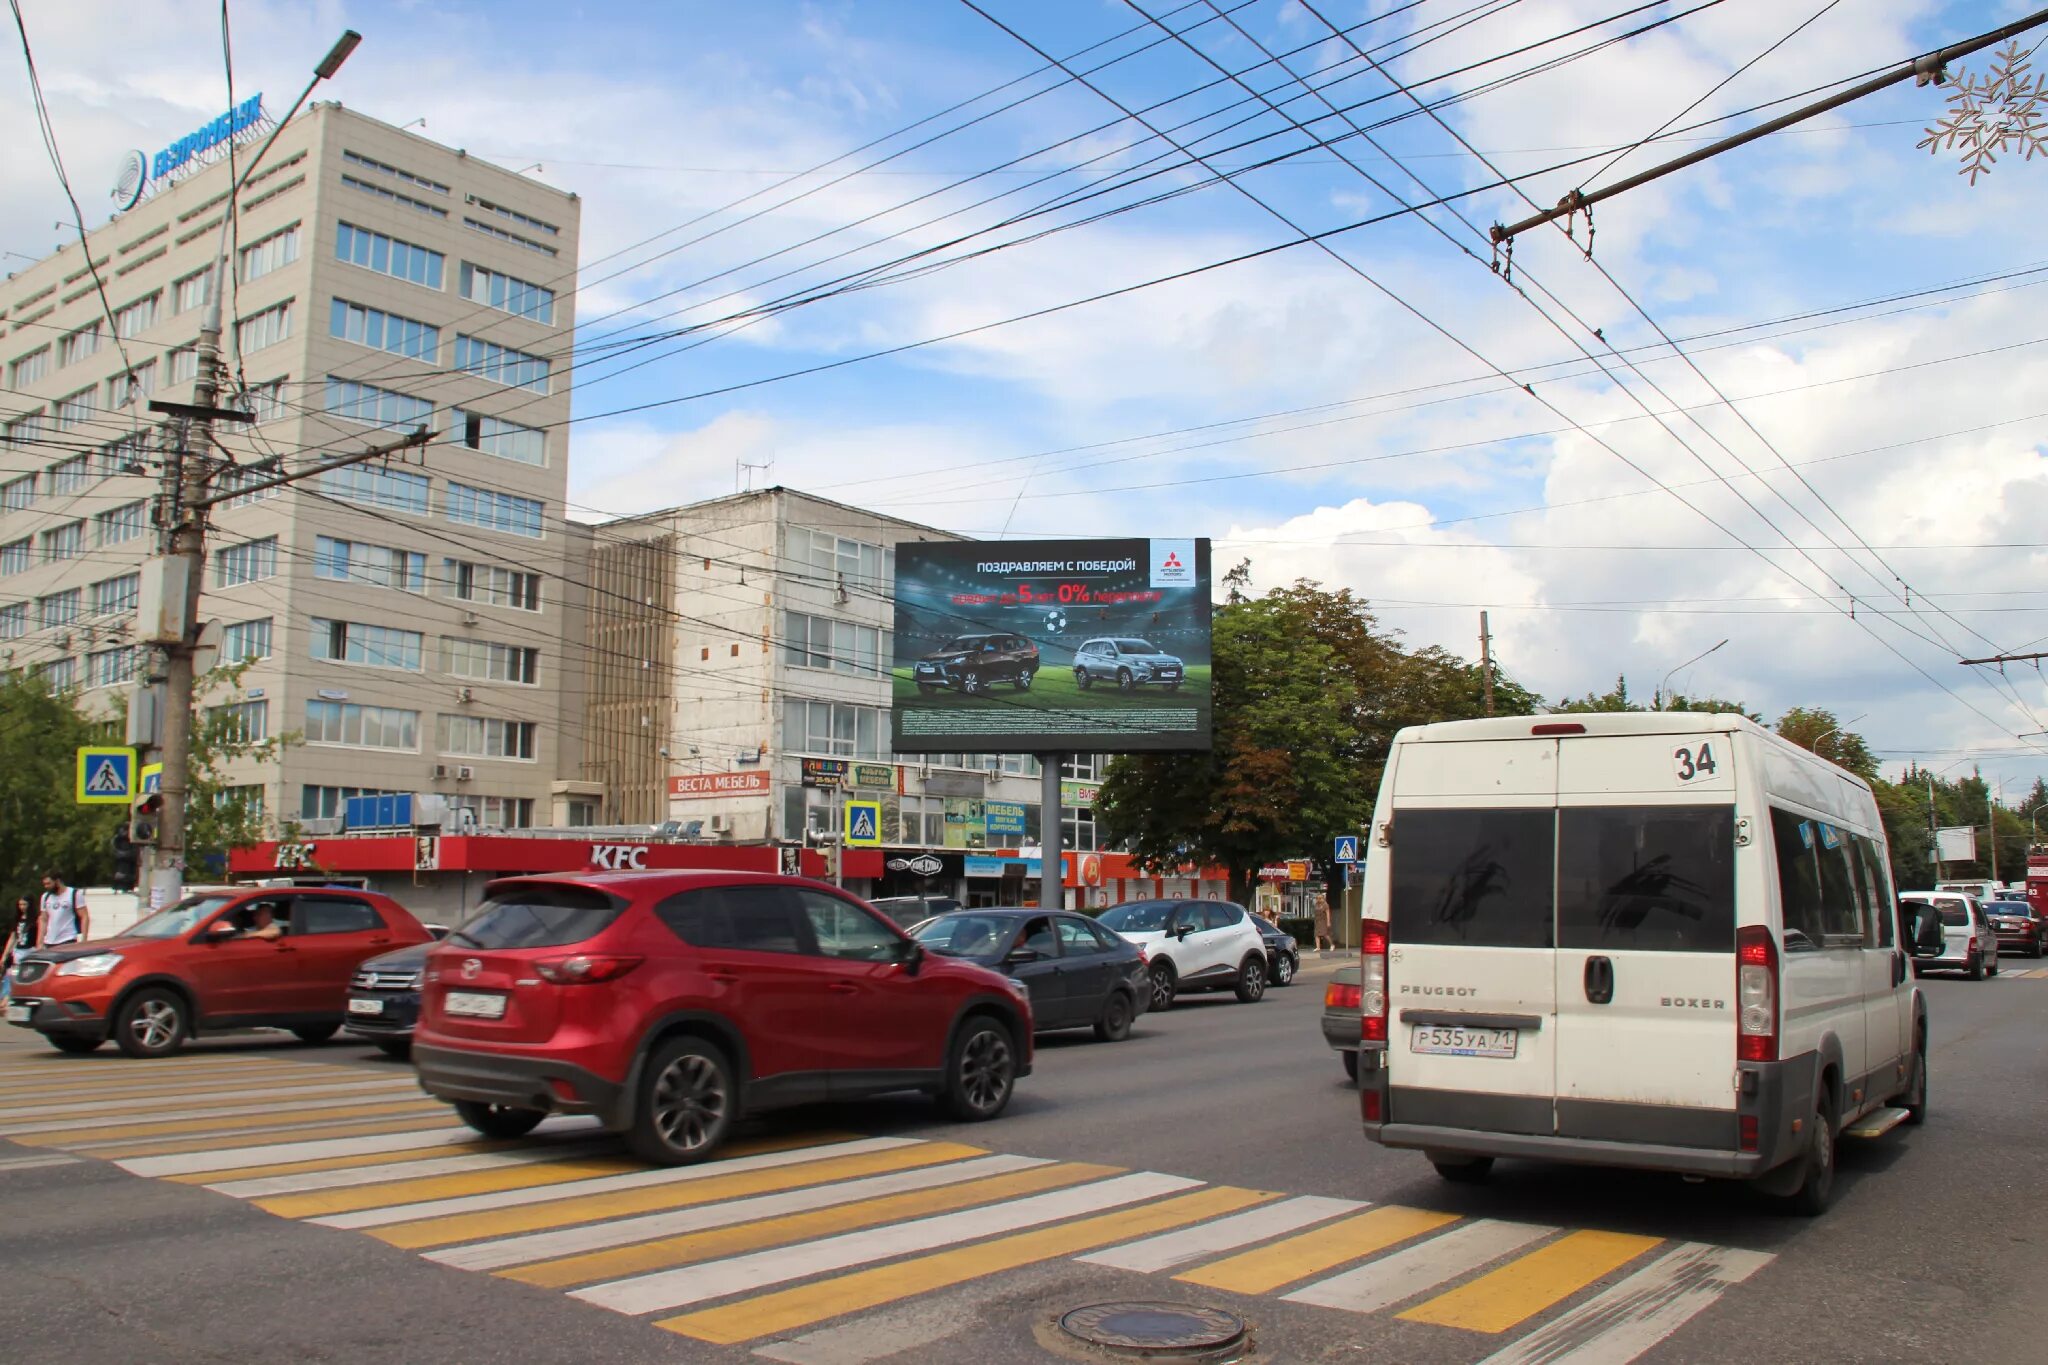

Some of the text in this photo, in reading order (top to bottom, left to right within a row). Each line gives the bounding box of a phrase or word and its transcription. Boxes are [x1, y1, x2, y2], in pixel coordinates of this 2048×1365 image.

[976, 558, 1136, 574] ПОЗДРАВЛЯЕМ С ПОБЕДОЙ!
[1018, 584, 1033, 603] 5
[1058, 583, 1090, 603] 0%
[1674, 743, 1716, 780] 34
[677, 774, 760, 792] ВЕСТА МЕБЕЛЬ
[987, 804, 1025, 817] МЕБЕЛЬ
[591, 845, 649, 869] KFC
[2028, 888, 2038, 896] 83
[1400, 984, 1478, 997] PEUGEOT
[1660, 997, 1725, 1009] BOXER
